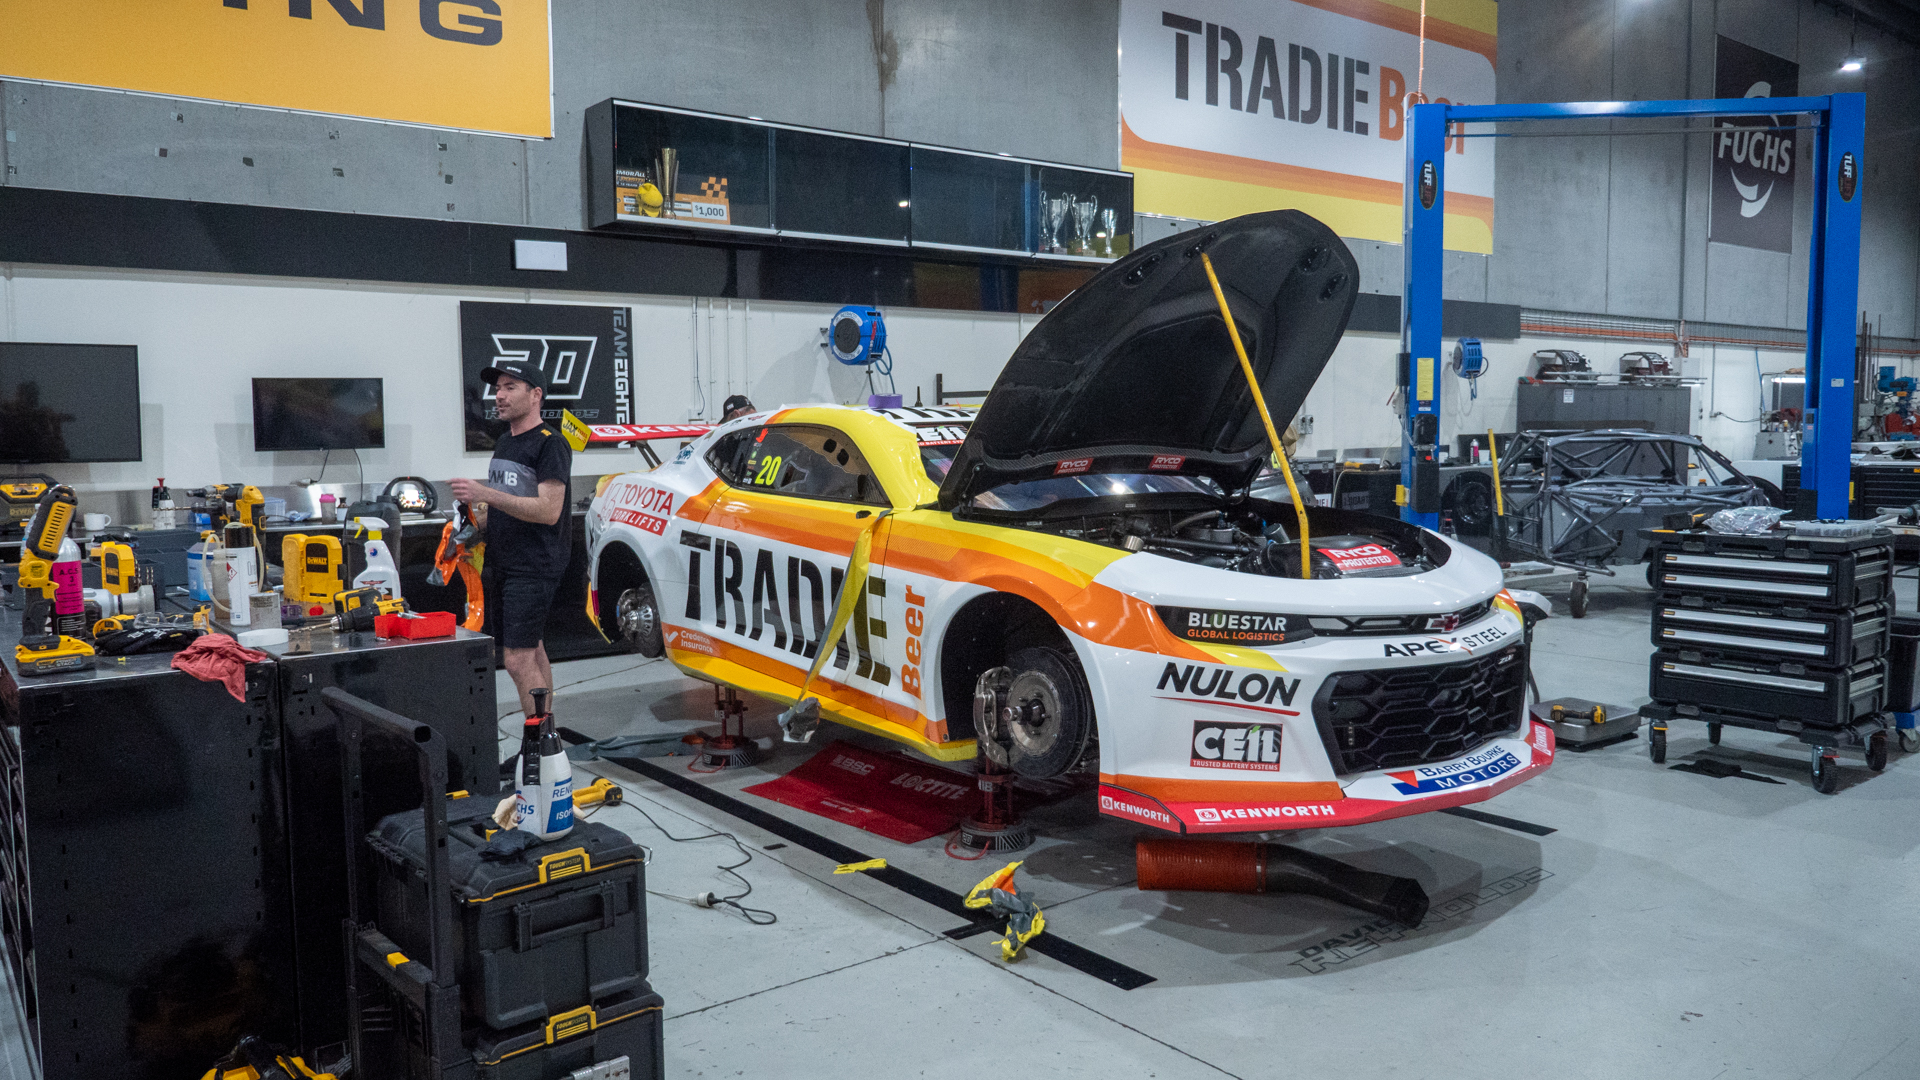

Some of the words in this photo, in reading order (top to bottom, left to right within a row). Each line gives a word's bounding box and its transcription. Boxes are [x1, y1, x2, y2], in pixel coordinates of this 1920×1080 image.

[1162, 11, 1369, 136] TRADIE
[1718, 122, 1792, 175] FUCHS
[695, 205, 724, 217] $1,000
[755, 455, 782, 486] 20
[1060, 460, 1088, 469] RYCO
[1154, 456, 1182, 464] RYCO
[622, 484, 674, 516] TOYOTA
[613, 508, 662, 532] FORKLIFTS
[1328, 546, 1381, 558] RYCO
[1342, 555, 1392, 567] PROTECTED
[1188, 612, 1287, 631] BLUESTAR
[681, 639, 713, 653] Insurance
[901, 584, 925, 700] Beer
[1187, 629, 1229, 639] GLOBAL
[1232, 632, 1285, 641] LOGISTICS
[1462, 626, 1507, 648] STEEL
[1156, 662, 1301, 707] NULON
[1193, 760, 1221, 768] TRUSTED
[1222, 761, 1249, 769] BATTERY
[1250, 763, 1278, 771] SYSTEMS
[1417, 761, 1468, 777] BARRY
[1467, 745, 1505, 766] BOURKE
[1435, 755, 1518, 788] MOTORS
[890, 772, 970, 800] LOCTITE
[1114, 800, 1170, 824] KENWORTH
[1221, 805, 1336, 819] KENWORTH
